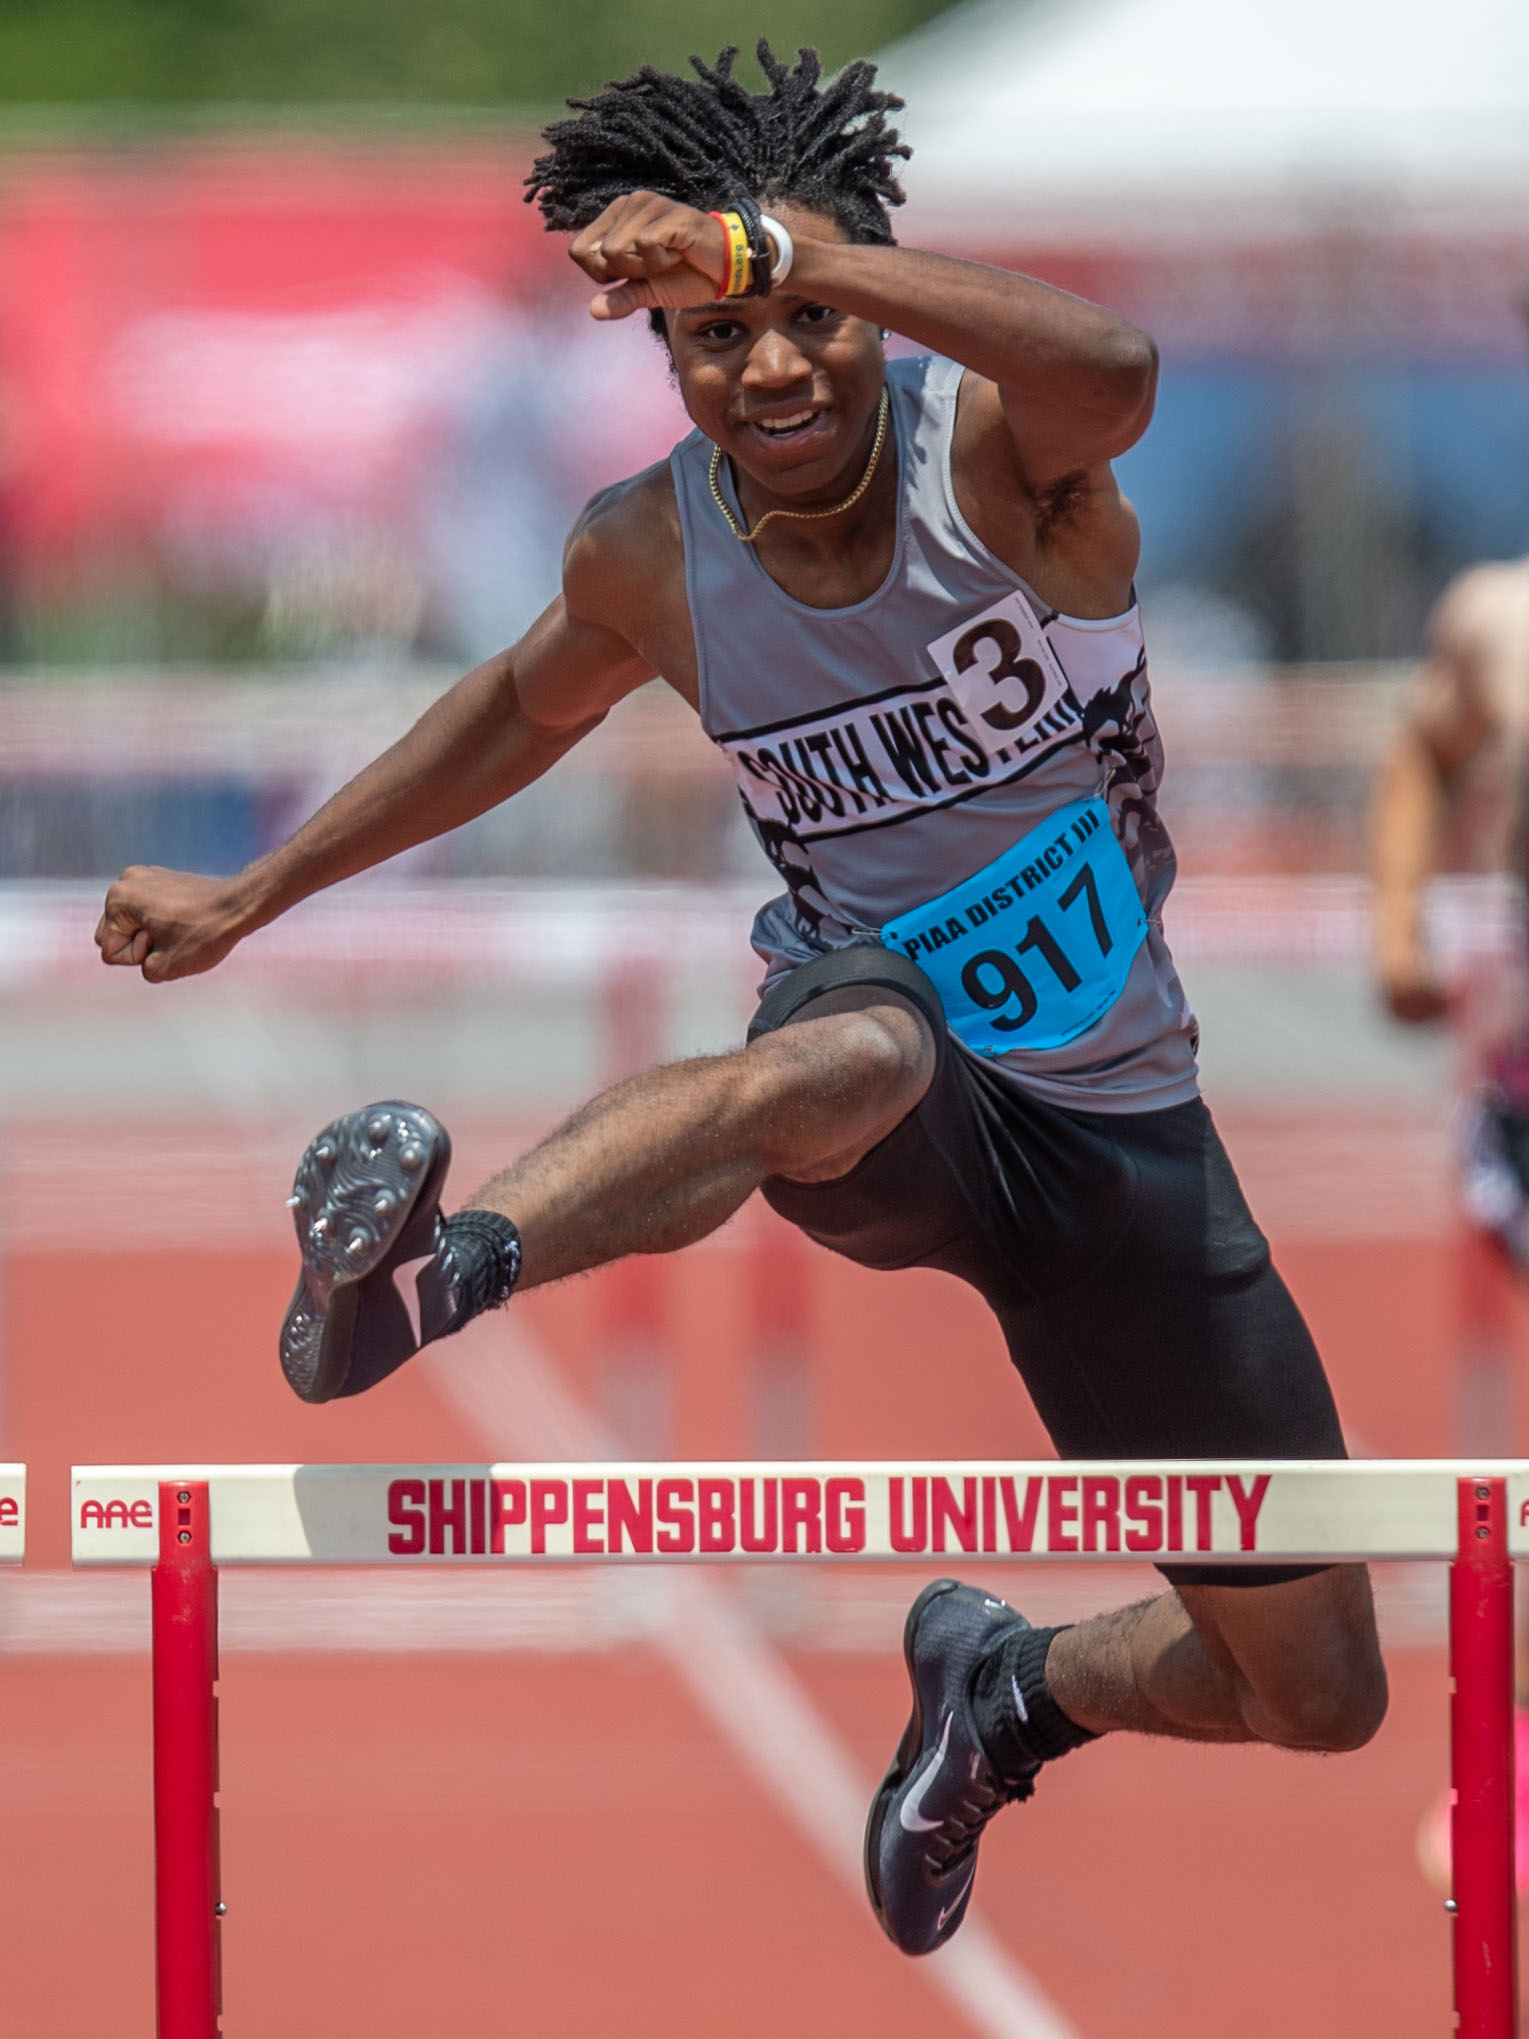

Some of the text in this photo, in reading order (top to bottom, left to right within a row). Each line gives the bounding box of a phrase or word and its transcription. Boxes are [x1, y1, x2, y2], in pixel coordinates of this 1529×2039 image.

[953, 617, 1047, 731] 3
[737, 722, 892, 824] SOUTH
[902, 809, 1100, 961] PIAA DISTRICT III
[961, 862, 1113, 1032] 917
[387, 1474, 1273, 1554] SHIPPENSBURG UNIVERSITY
